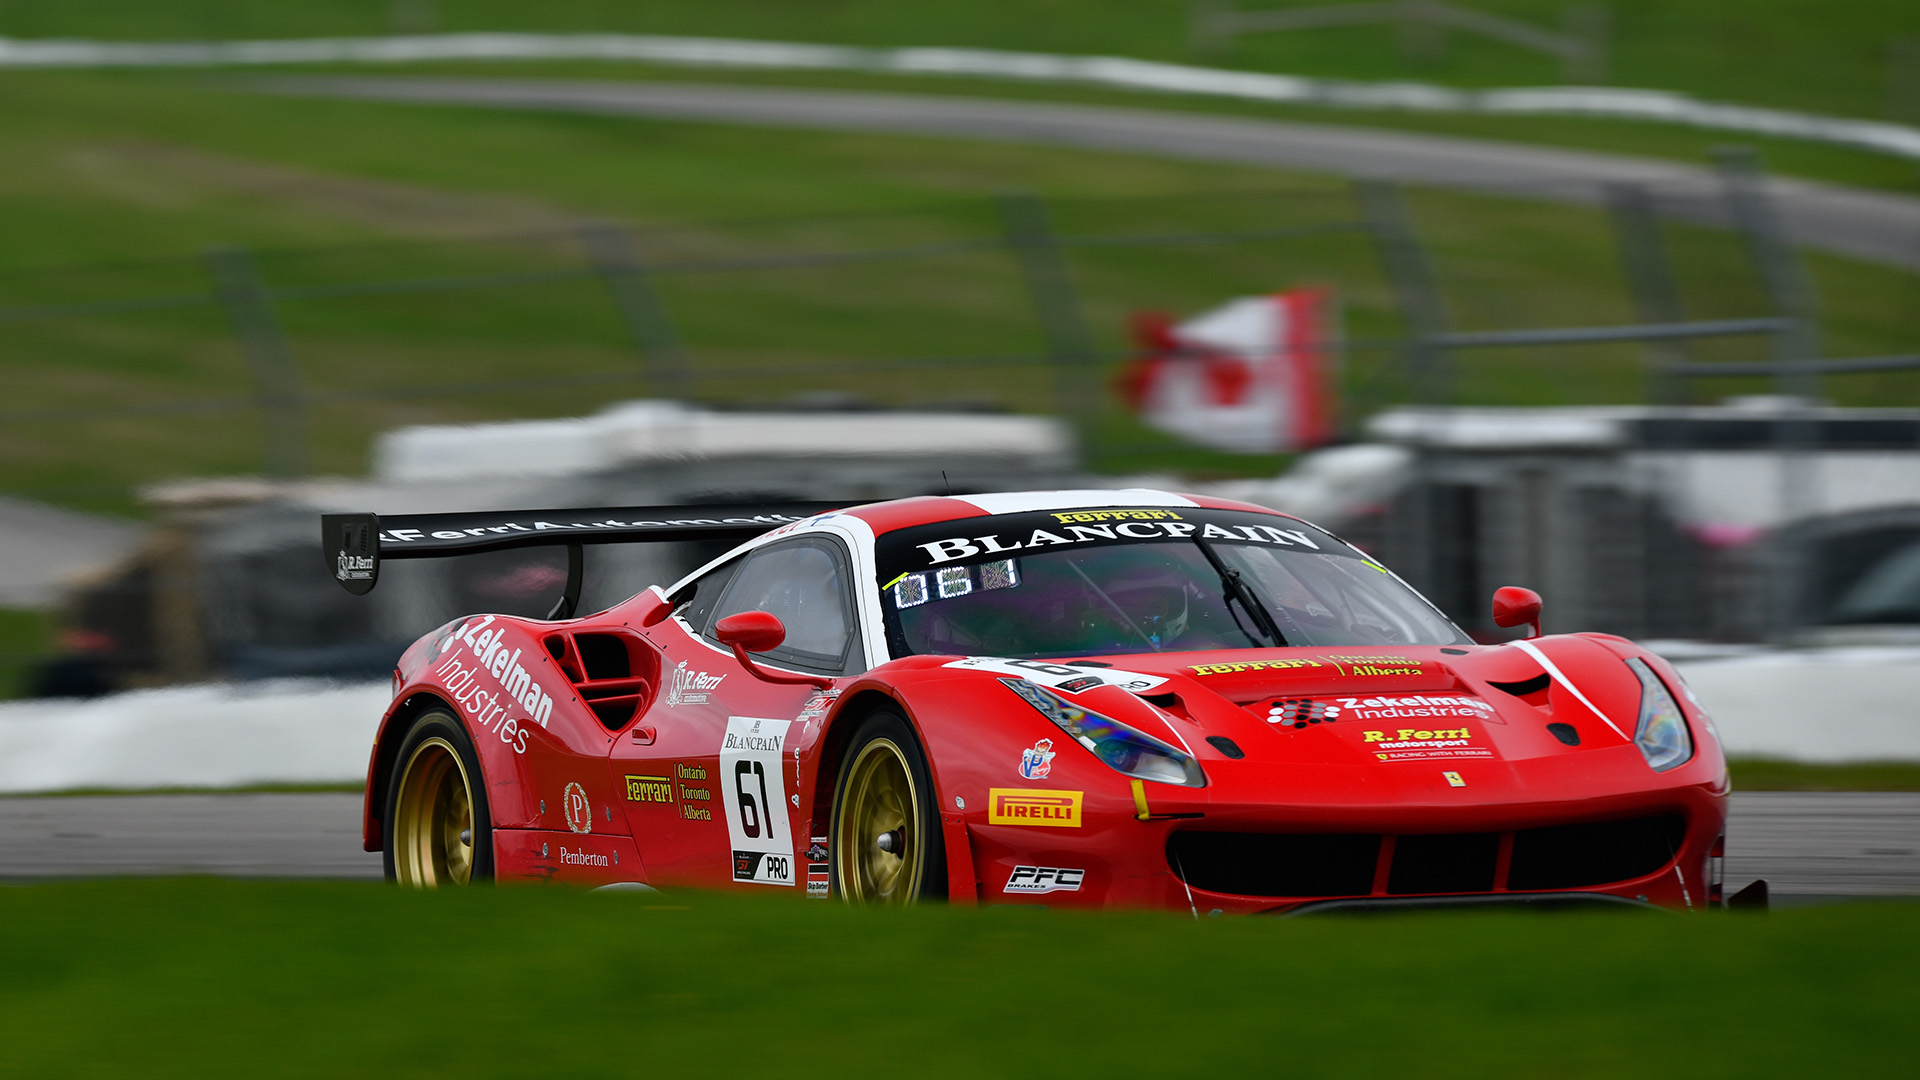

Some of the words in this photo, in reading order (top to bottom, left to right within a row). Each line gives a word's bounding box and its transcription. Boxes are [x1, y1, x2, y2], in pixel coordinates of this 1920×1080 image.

[1050, 509, 1183, 524] Ferrari
[916, 522, 1320, 565] BLANCPAIN
[463, 614, 553, 729] Zekelman
[1187, 658, 1323, 676] Ferrari
[1352, 665, 1423, 676] Alberta
[436, 648, 530, 754] Industries
[1336, 696, 1496, 712] Zekelman
[1354, 706, 1490, 720] Industries
[725, 733, 782, 751] BLANCPAIN
[1379, 739, 1468, 748] motorsport
[1396, 728, 1472, 741] Ferri
[678, 763, 707, 780] Ontario
[624, 774, 674, 803] Ferrari
[680, 784, 711, 801] Toronto
[735, 760, 774, 839] 61
[996, 795, 1074, 820] PIRELLI
[683, 804, 712, 821] Alberta
[560, 846, 609, 867] Pemberton
[766, 856, 789, 880] PRO
[1010, 866, 1084, 885] PFC
